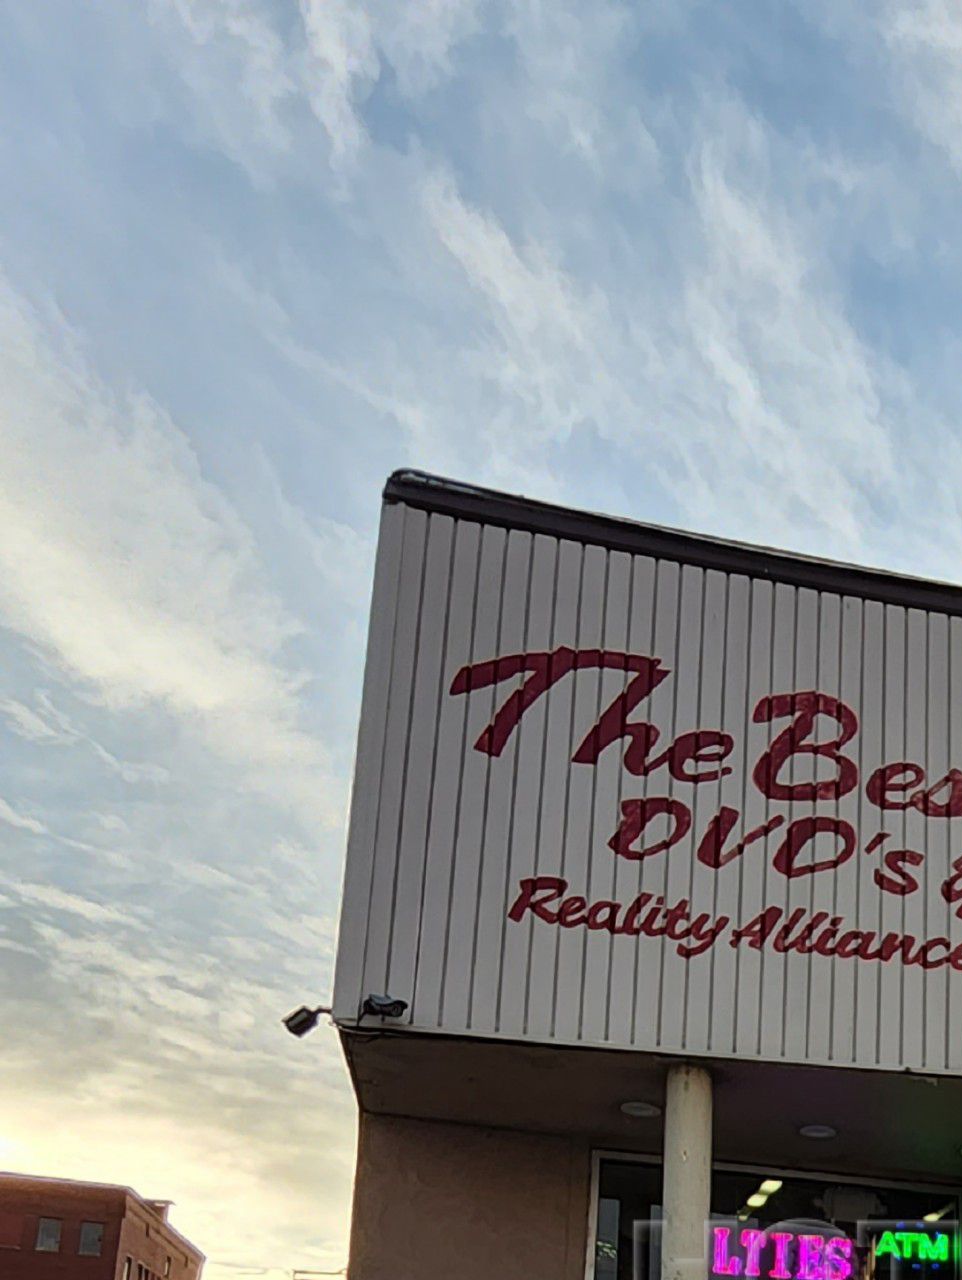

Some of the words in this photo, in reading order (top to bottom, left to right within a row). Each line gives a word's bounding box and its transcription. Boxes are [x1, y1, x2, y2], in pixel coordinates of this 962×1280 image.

[451, 645, 735, 783] The
[508, 876, 730, 960] Reality
[874, 1230, 949, 1261] ATM
